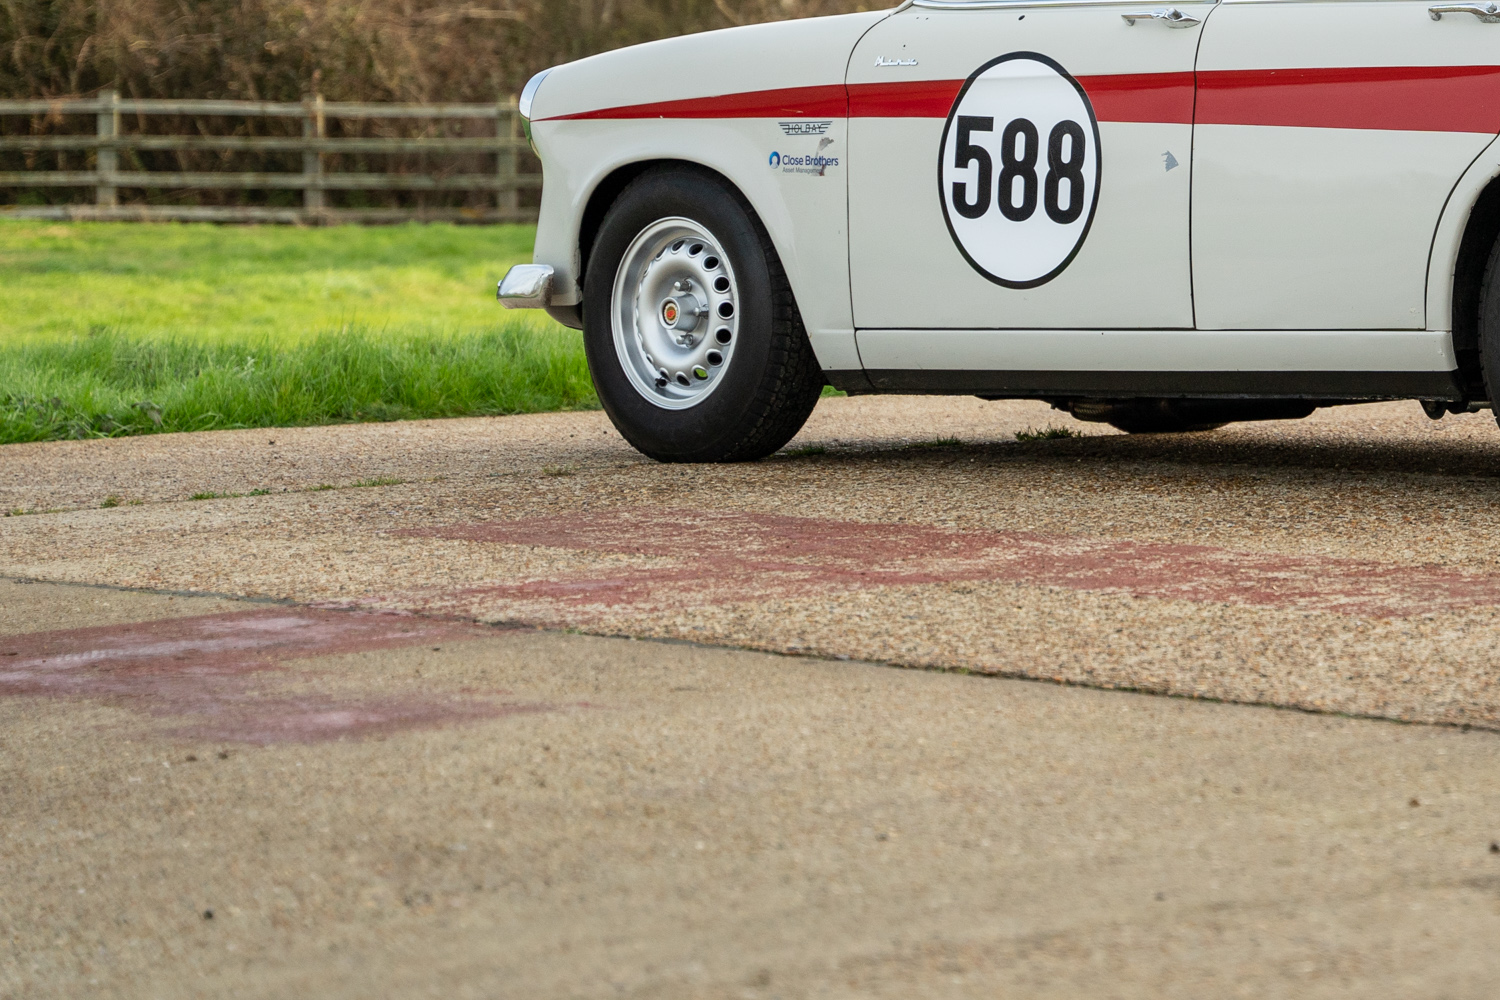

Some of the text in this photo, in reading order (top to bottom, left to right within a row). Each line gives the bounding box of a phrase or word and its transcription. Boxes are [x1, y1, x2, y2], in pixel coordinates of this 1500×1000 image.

[782, 155, 839, 167] Close Brothers
[952, 115, 1086, 224] 588
